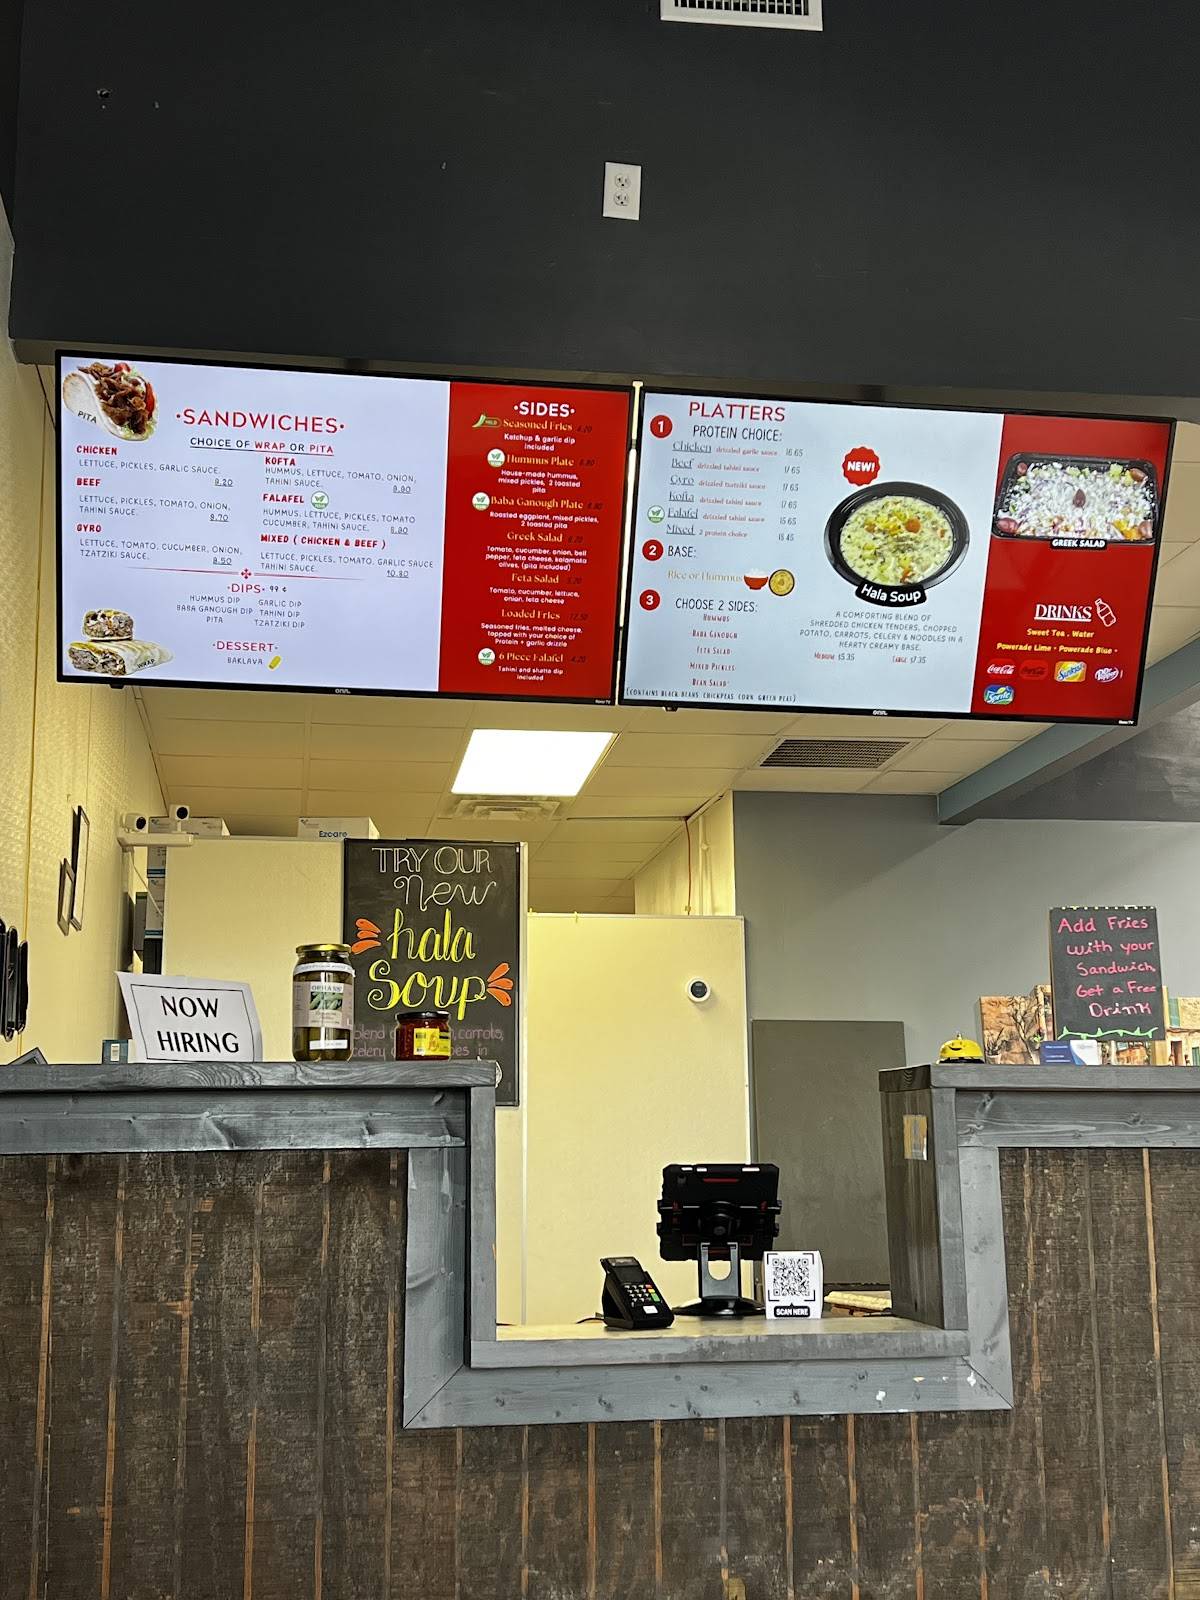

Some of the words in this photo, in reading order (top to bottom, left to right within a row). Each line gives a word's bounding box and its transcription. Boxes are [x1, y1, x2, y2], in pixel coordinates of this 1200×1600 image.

[520, 402, 570, 417] SIDES
[689, 402, 785, 421] PLATTERS
[78, 411, 97, 423] PITA
[183, 408, 338, 434] SANDWICHES
[503, 419, 547, 429] Seasoned
[550, 421, 572, 431] Fries
[693, 425, 737, 438] PROTEIN
[742, 428, 782, 441] CHOICE:
[504, 434, 532, 442] Ketchup
[564, 436, 575, 444] dip
[76, 446, 117, 455] CHICKEN
[190, 438, 231, 447] CHOICE
[236, 440, 250, 448] OF
[255, 442, 285, 450] WRAP
[310, 444, 333, 453] PITA
[524, 443, 554, 451] included
[673, 441, 712, 451] Chicken
[265, 457, 295, 466] KOFTA
[507, 454, 548, 464] Hummus
[551, 456, 574, 466] Plate
[672, 458, 694, 467] Beef
[847, 461, 875, 472] NEW!
[76, 478, 101, 486] BEEF
[670, 475, 694, 485] Gyro
[80, 495, 118, 504] LETTUCE,
[121, 498, 156, 507] PICKLES,
[160, 500, 197, 509] TOMATO,
[200, 502, 230, 510] ONION,
[263, 494, 304, 503] FALAFEL
[491, 496, 514, 505] Baba
[517, 498, 558, 509] Ganough
[561, 499, 583, 509] Plate
[304, 511, 341, 520] LETTUCE,
[344, 513, 379, 522] PICKLES,
[382, 515, 415, 523] TOMATO
[76, 524, 101, 532] GYRO
[263, 519, 309, 529] CUCUMBER,
[313, 522, 339, 530] TAHINI
[261, 535, 289, 543] MIXED
[301, 537, 340, 546] CHICKEN
[355, 540, 378, 548] BEEF
[507, 532, 535, 541] Greek
[538, 533, 562, 542] Salad
[1052, 539, 1077, 547] GREEK
[1079, 540, 1105, 548] SALAD
[649, 546, 656, 555] 2
[668, 546, 696, 557] BASE:
[261, 563, 286, 571] TAHINI
[409, 560, 433, 568] SAUCE
[512, 573, 531, 582] Feta
[534, 574, 559, 583] Salad
[231, 584, 261, 593] DIPS
[861, 584, 887, 602] Hala
[890, 590, 921, 602] Soup
[190, 595, 224, 603] HUMMUS
[647, 596, 653, 605] 3
[676, 599, 714, 610] CHOOSE
[718, 601, 724, 610] 2
[728, 601, 758, 612] SIDES:
[199, 606, 237, 614] GANOUGH
[502, 609, 535, 618] Loaded
[538, 610, 560, 619] Fries
[1035, 604, 1092, 619] DRINKS
[843, 612, 893, 620] COMFORTING
[810, 620, 848, 628] SHREDDED
[885, 623, 920, 631] TENDERS,
[800, 630, 832, 638] POTATO,
[834, 631, 871, 639] CARROTS,
[910, 634, 945, 642] NOODLES
[217, 641, 274, 652] DESSERT
[997, 643, 1032, 651] Powerade
[372, 848, 429, 872] TRY
[434, 847, 493, 874] OUR
[1058, 918, 1096, 933] Add
[1108, 916, 1148, 930] Fries
[387, 908, 475, 962] hala
[1067, 940, 1112, 955] with
[1120, 943, 1154, 955] your
[368, 960, 486, 1020] Soup
[1076, 985, 1104, 997] Get
[1128, 981, 1156, 993] Free
[161, 995, 218, 1018] NOW
[157, 1030, 239, 1053] HIRING
[776, 1308, 792, 1316] SCAN
[793, 1308, 808, 1316] HERE
